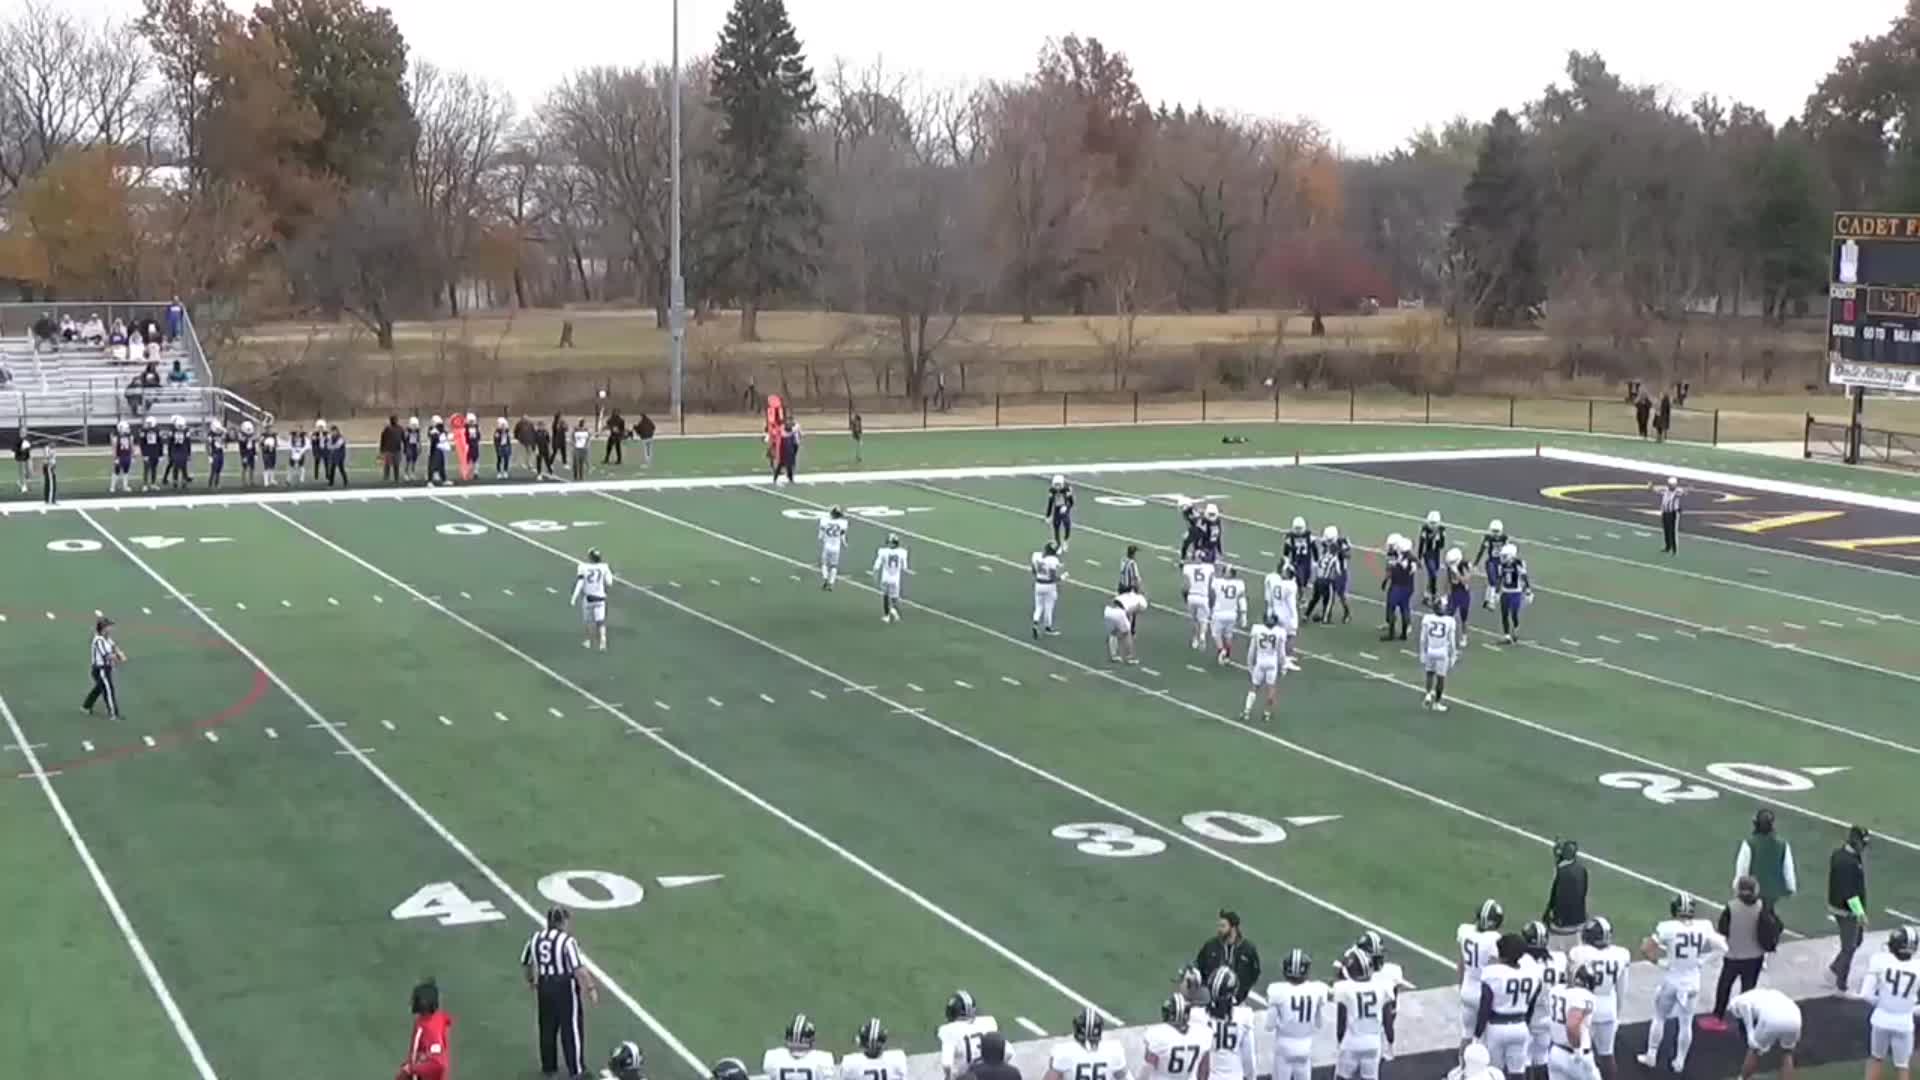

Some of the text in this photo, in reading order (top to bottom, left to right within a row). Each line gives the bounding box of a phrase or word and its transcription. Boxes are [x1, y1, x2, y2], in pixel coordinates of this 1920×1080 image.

[1838, 216, 1899, 236] CADET
[586, 568, 602, 584] 27
[1220, 585, 1237, 599] 43
[1259, 632, 1277, 649] 29
[1428, 621, 1446, 638] 23
[1599, 762, 1815, 804] 20
[1051, 810, 1287, 856] 30
[390, 869, 644, 926] 40
[538, 940, 552, 964] S
[1464, 938, 1479, 968] 51
[1674, 932, 1703, 959] 24
[1506, 976, 1534, 1007] 99
[1885, 967, 1917, 999] 47
[1290, 995, 1312, 1023] 41
[1356, 990, 1377, 1019] 12
[1168, 1045, 1201, 1074] 67
